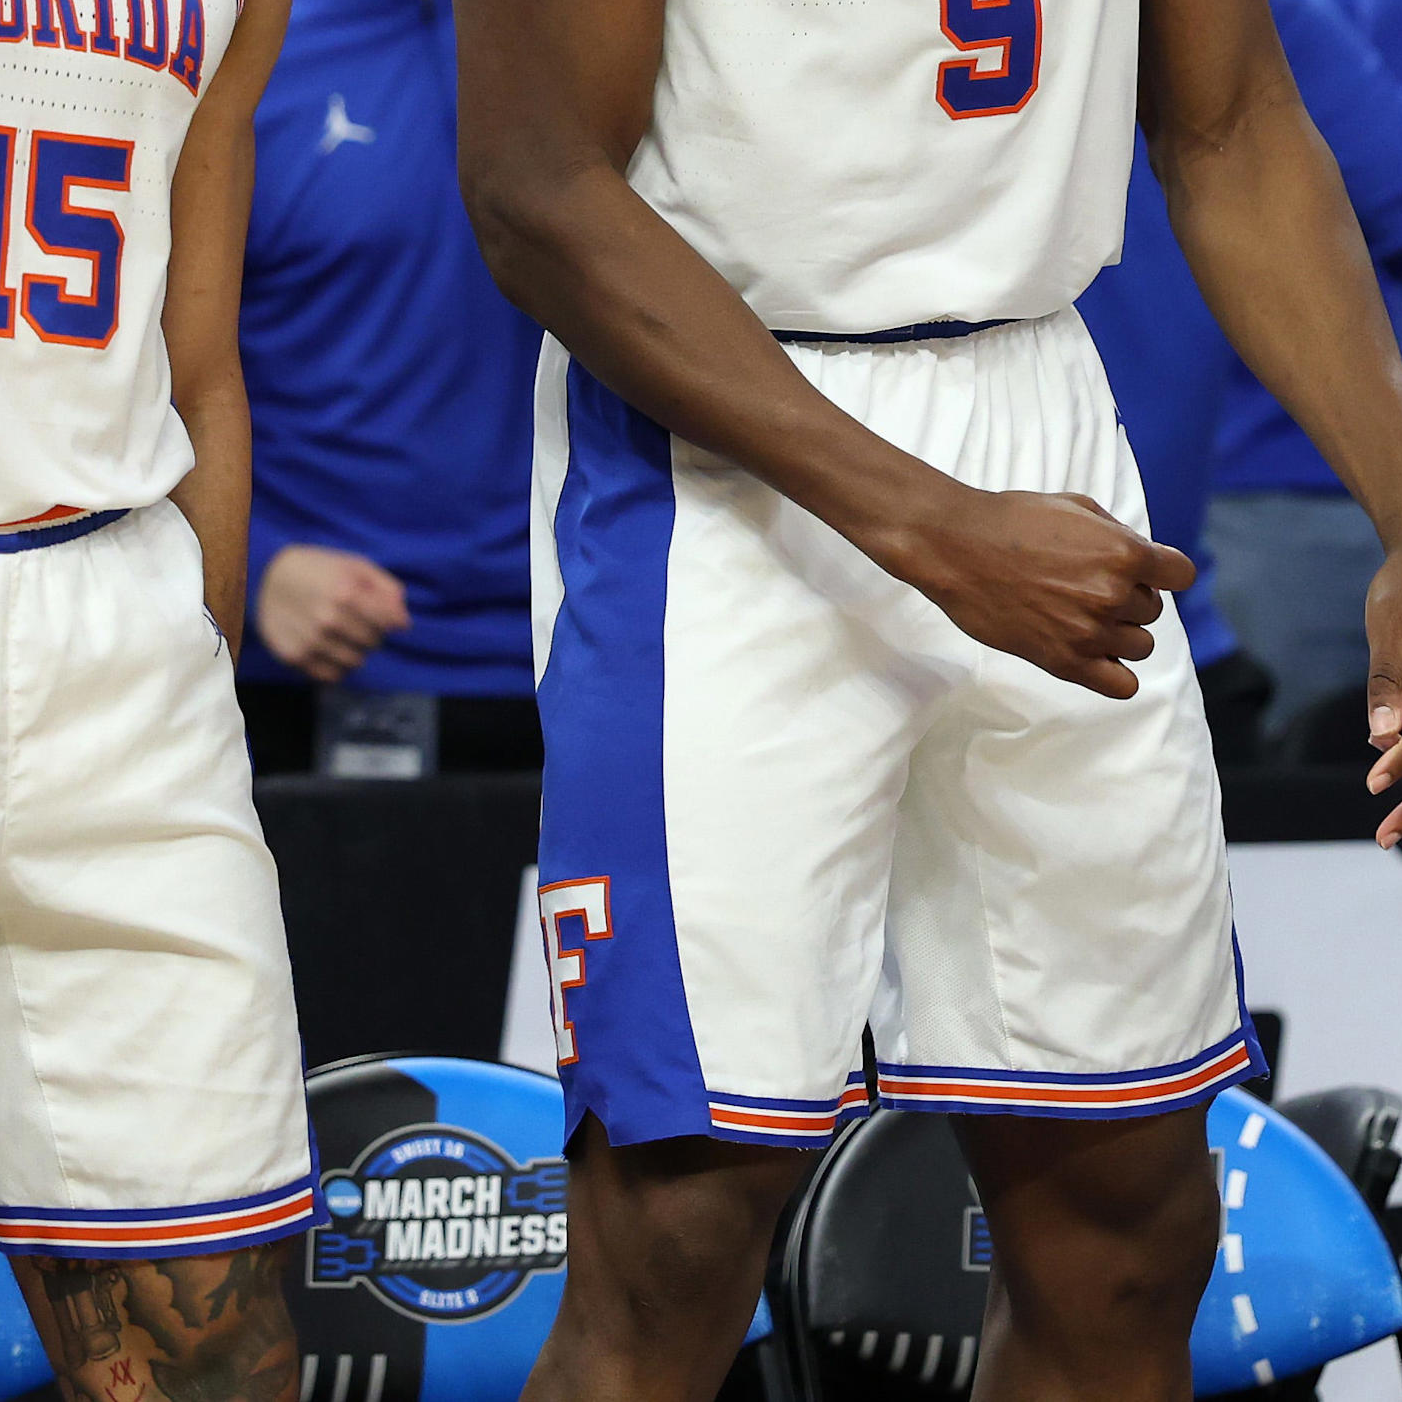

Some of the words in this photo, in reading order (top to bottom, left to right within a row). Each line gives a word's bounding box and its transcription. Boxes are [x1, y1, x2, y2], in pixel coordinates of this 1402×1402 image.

[538, 875, 614, 1066] F
[363, 1175, 503, 1220] MARCH
[384, 1212, 568, 1262] MADNESS
